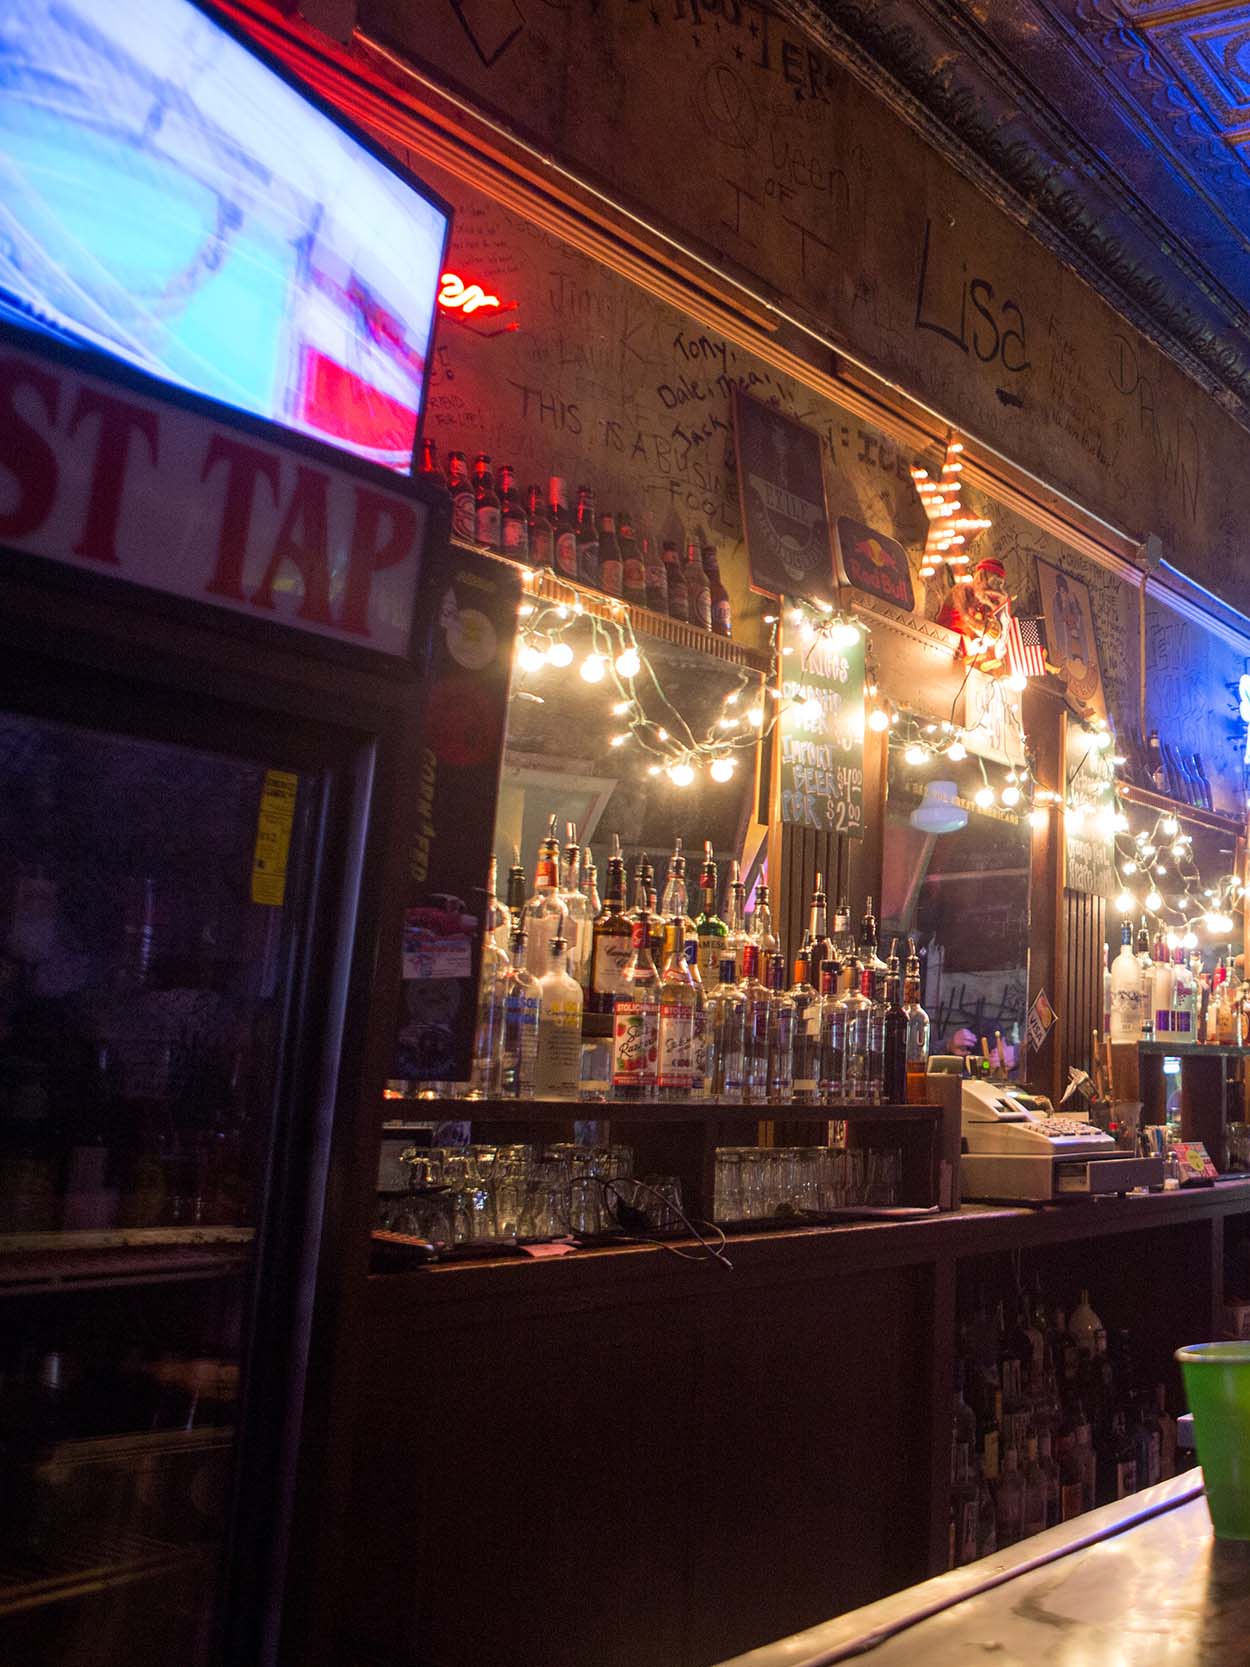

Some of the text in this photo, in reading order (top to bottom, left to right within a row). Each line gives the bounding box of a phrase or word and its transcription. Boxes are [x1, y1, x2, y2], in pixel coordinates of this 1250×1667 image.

[914, 218, 1032, 372] Lisa
[507, 379, 582, 435] THIS
[599, 419, 625, 452] IS
[632, 432, 648, 464] A
[200, 432, 418, 638] TAP
[882, 573, 908, 602] Bull
[782, 789, 822, 830] PBR
[793, 765, 840, 799] BEER
